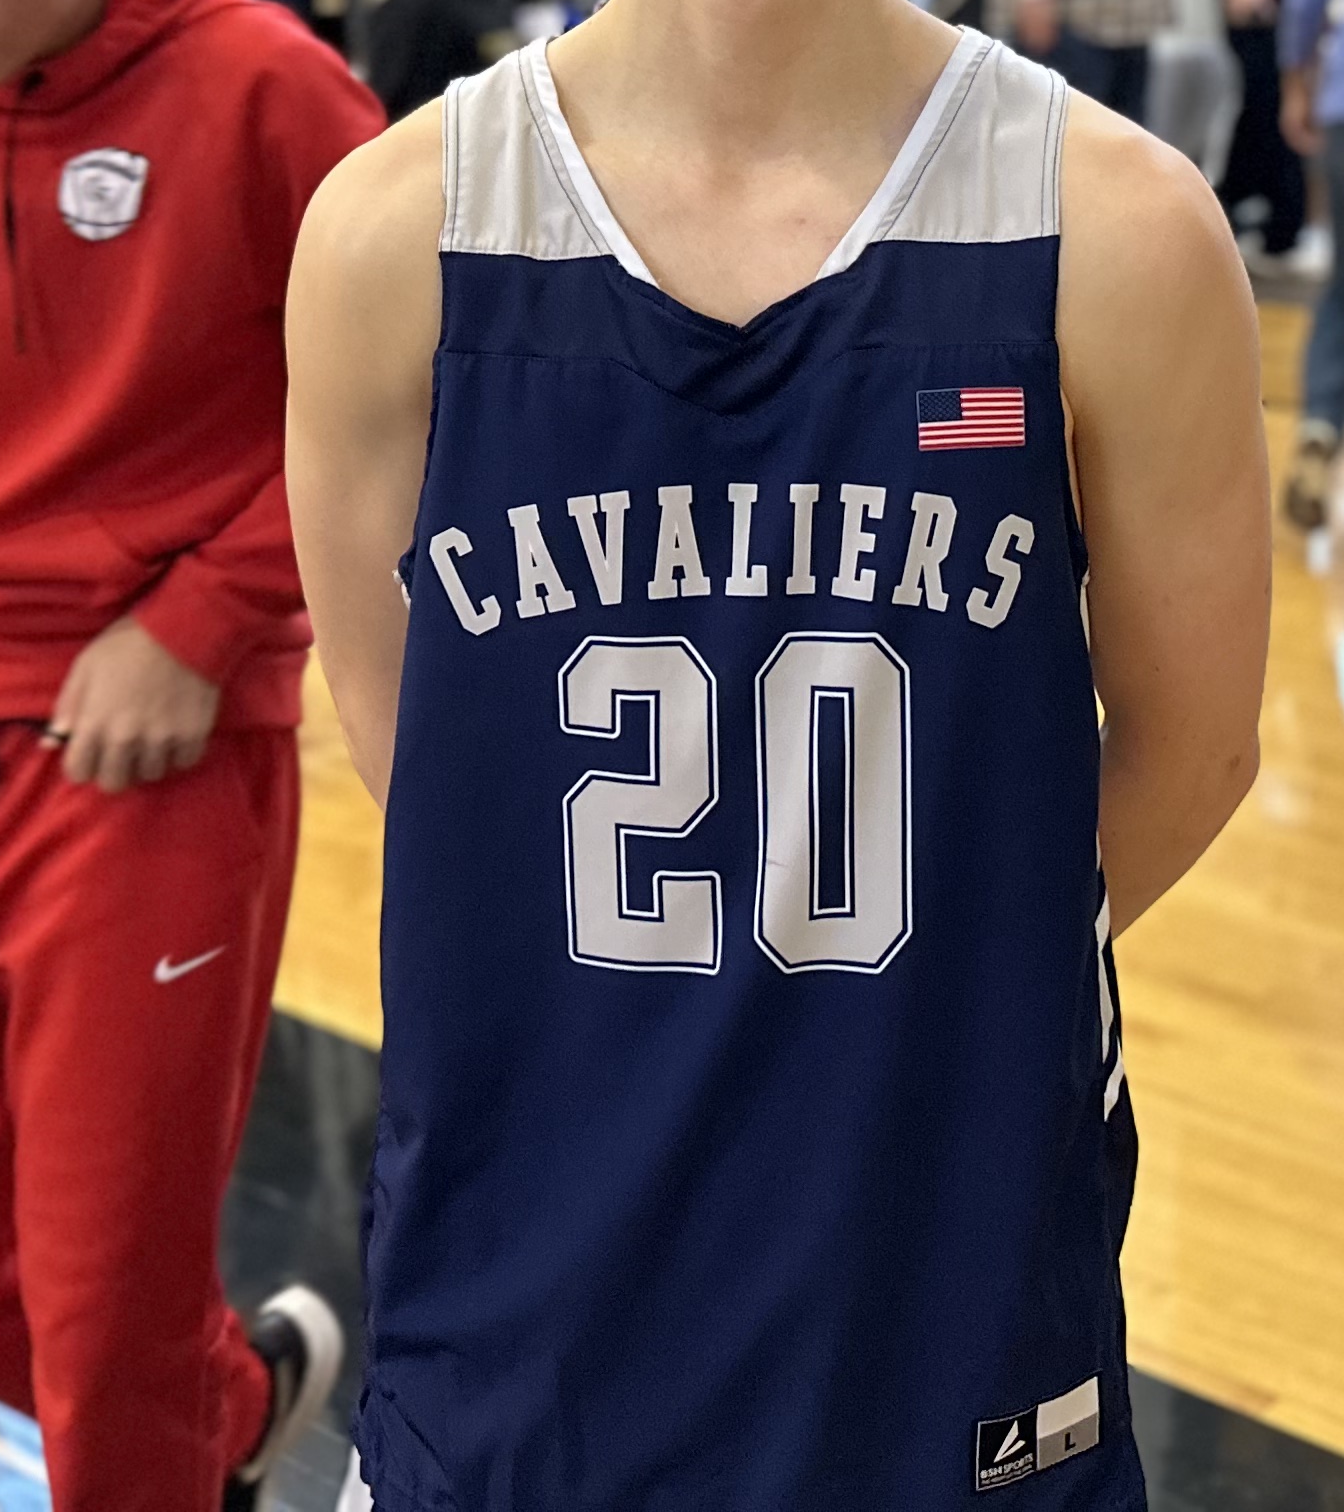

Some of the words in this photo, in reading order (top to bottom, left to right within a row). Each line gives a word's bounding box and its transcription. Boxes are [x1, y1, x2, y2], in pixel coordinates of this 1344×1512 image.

[427, 482, 1035, 636] CAVALIERS
[557, 630, 913, 976] 20
[1065, 1432, 1076, 1451] L
